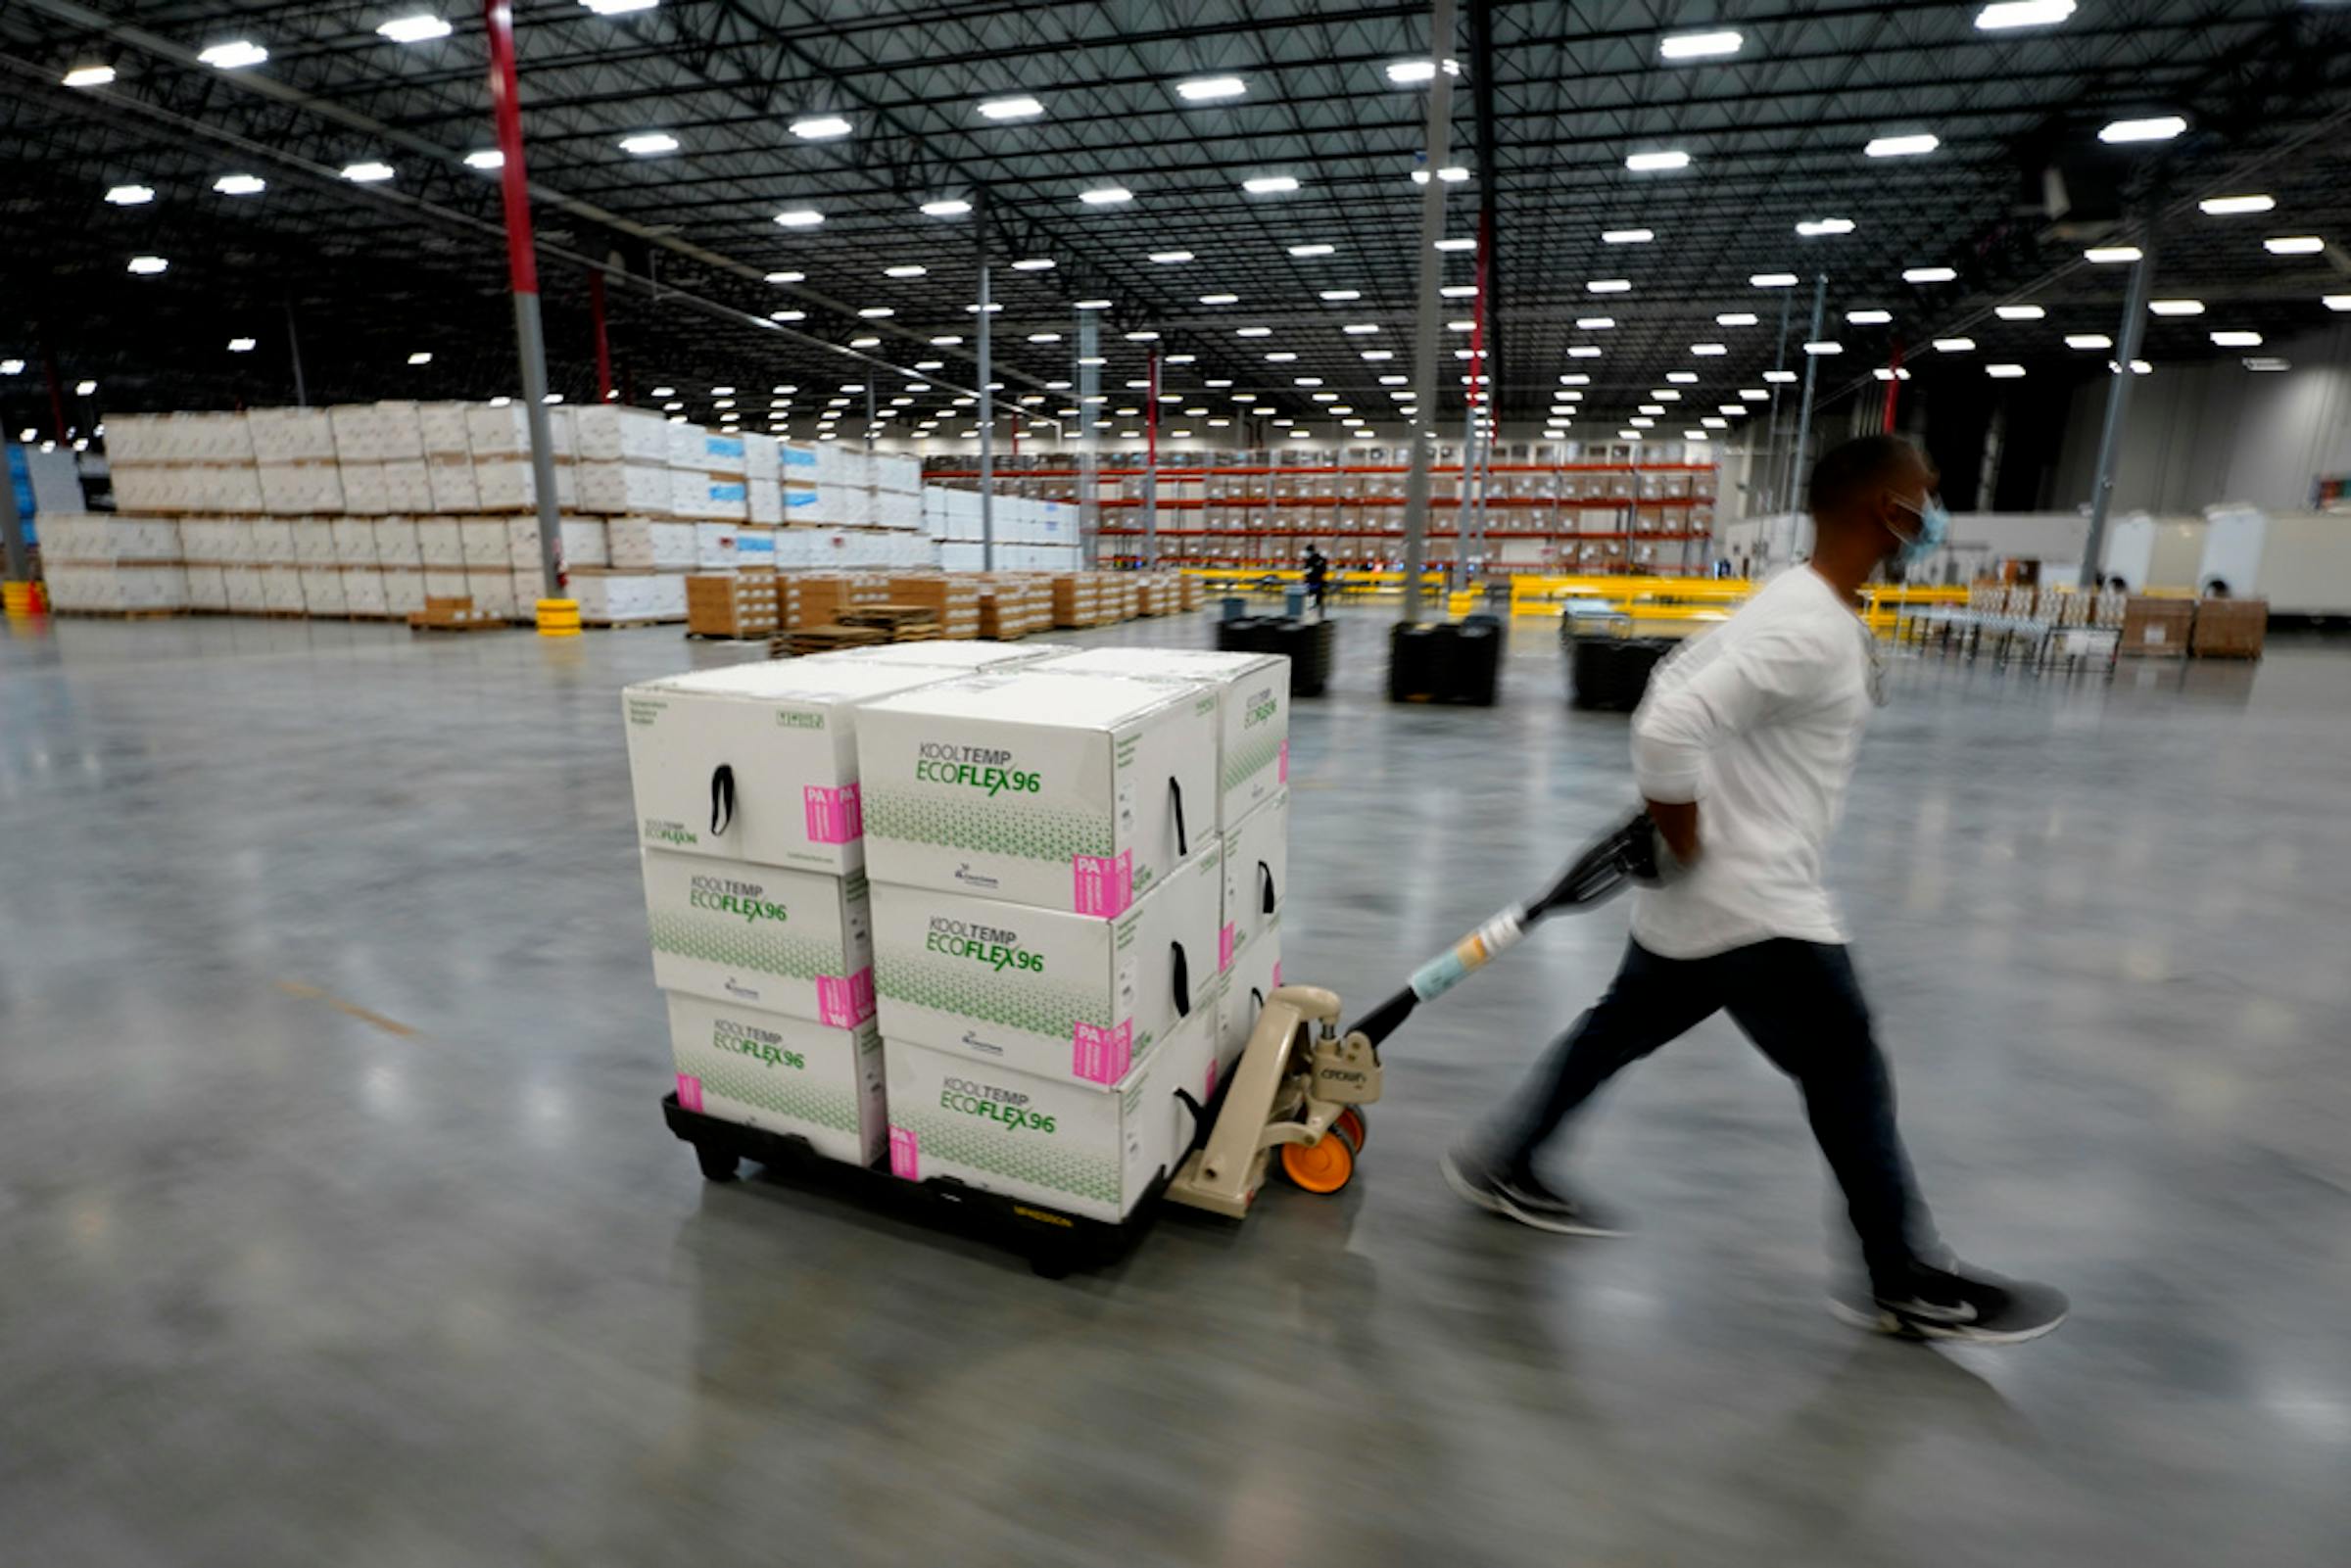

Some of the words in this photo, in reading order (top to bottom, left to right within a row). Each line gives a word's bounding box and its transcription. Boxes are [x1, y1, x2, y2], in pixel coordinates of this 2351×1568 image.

[920, 742, 1012, 766] KOOLTEMP
[916, 760, 1041, 797] ECOFLEX96
[692, 876, 763, 897] KOOLTEMP
[930, 916, 1017, 945] KOOLTEMP
[926, 931, 1044, 973] ECOFLEX96
[714, 1019, 783, 1045] KOOLTEMP
[942, 1076, 1030, 1106] KOOLTEMP
[940, 1090, 1057, 1133] ECOFLEX96
